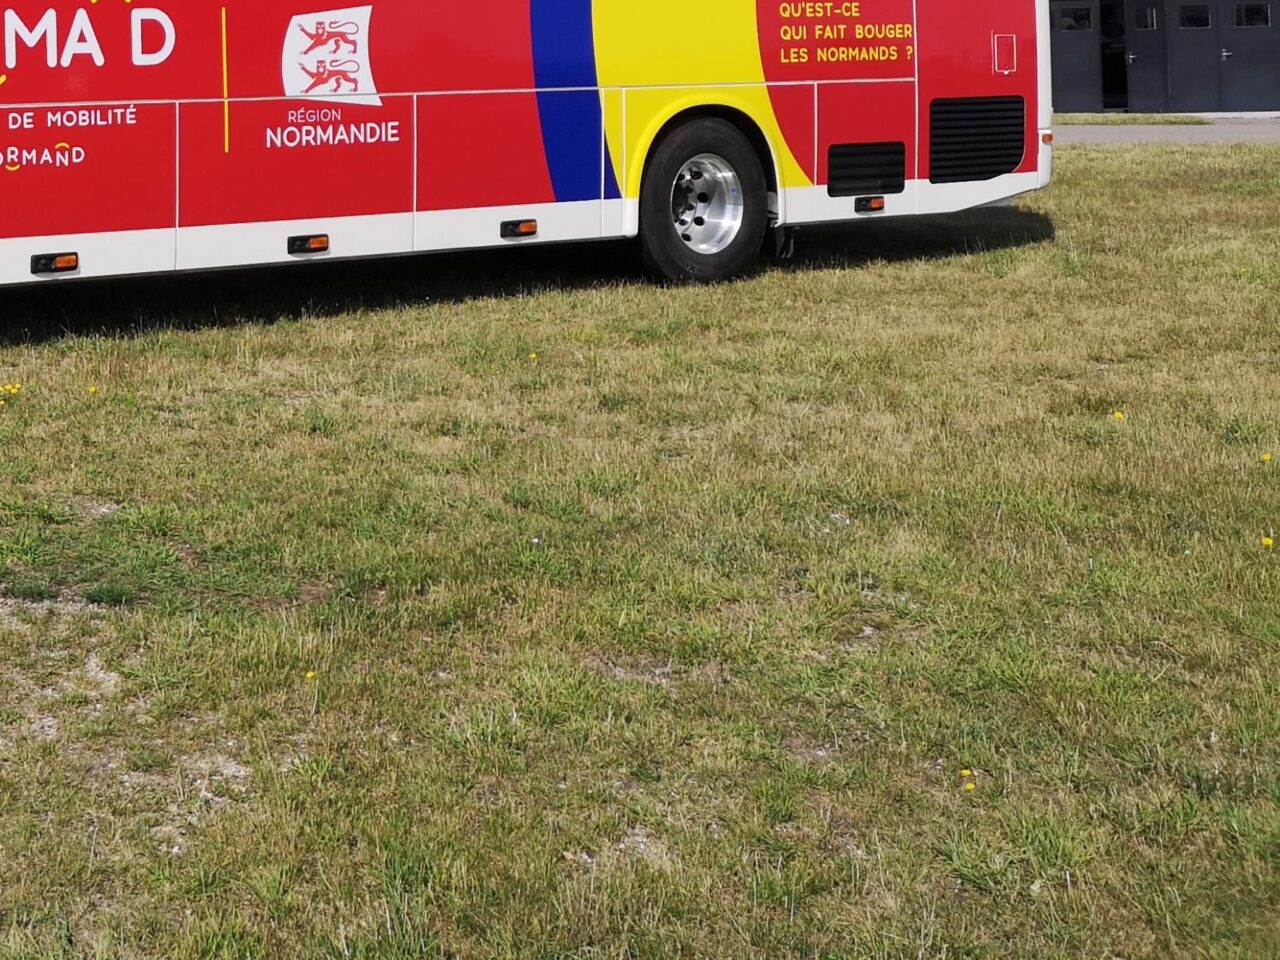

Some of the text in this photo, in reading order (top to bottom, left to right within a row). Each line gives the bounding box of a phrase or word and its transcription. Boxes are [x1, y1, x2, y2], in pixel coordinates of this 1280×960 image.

[779, 2, 861, 18] QU'EST-CE
[780, 23, 913, 40] QUI FAIT BOUGER
[780, 48, 809, 63] LES
[817, 46, 899, 62] NORMANDS
[8, 112, 35, 129] DE
[47, 104, 137, 128] MOBILITÉ
[287, 107, 342, 123] RÉGION
[266, 121, 400, 148] NORMANDIE
